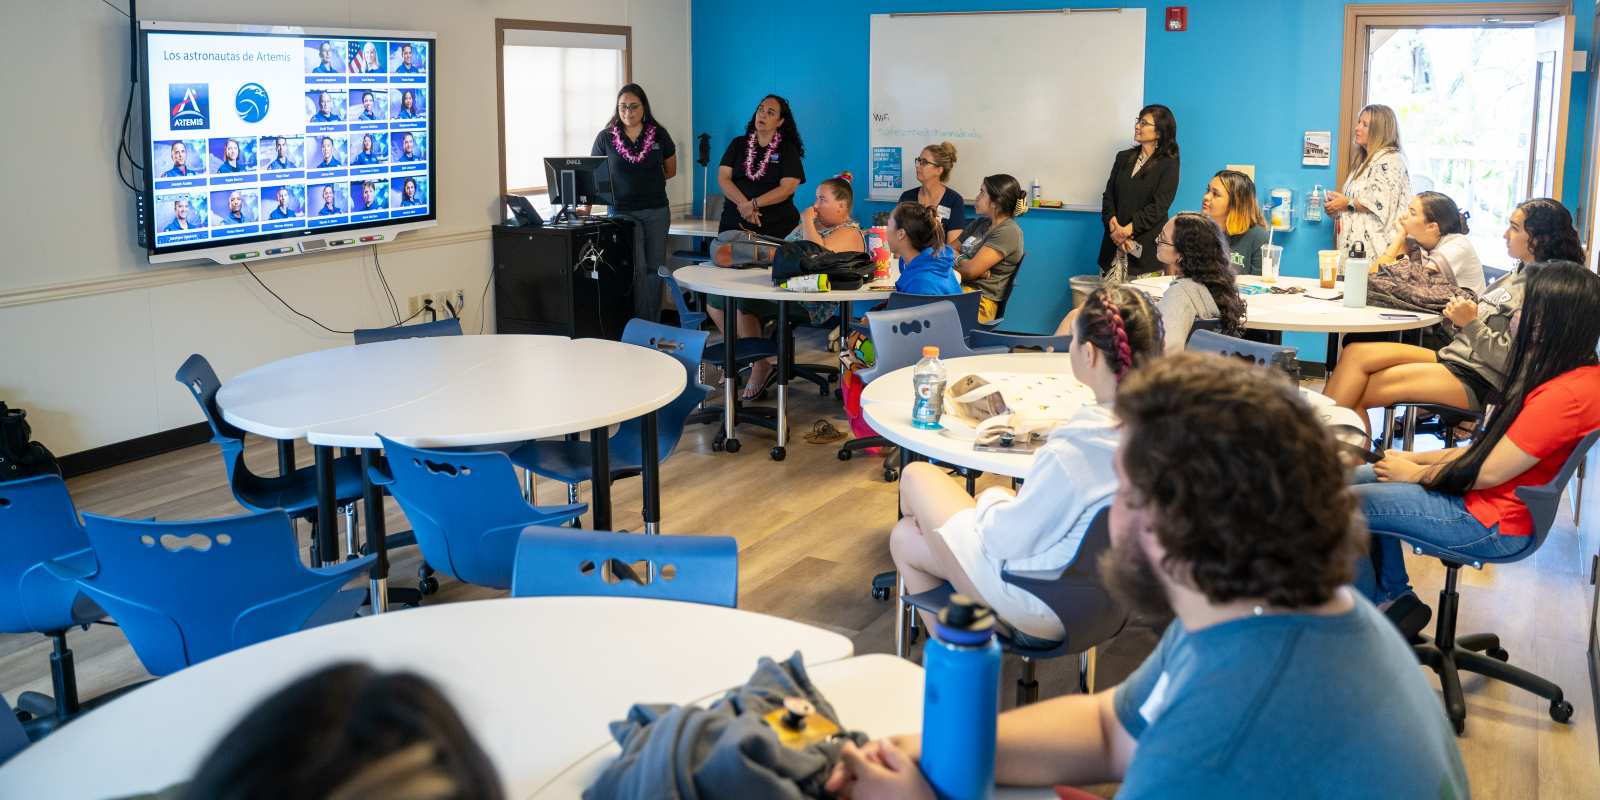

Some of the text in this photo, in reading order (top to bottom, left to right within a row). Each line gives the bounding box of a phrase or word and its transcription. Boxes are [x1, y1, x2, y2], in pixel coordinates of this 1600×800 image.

[163, 50, 291, 62] Los astronautas de Artemis
[174, 118, 204, 127] ARTEMIS
